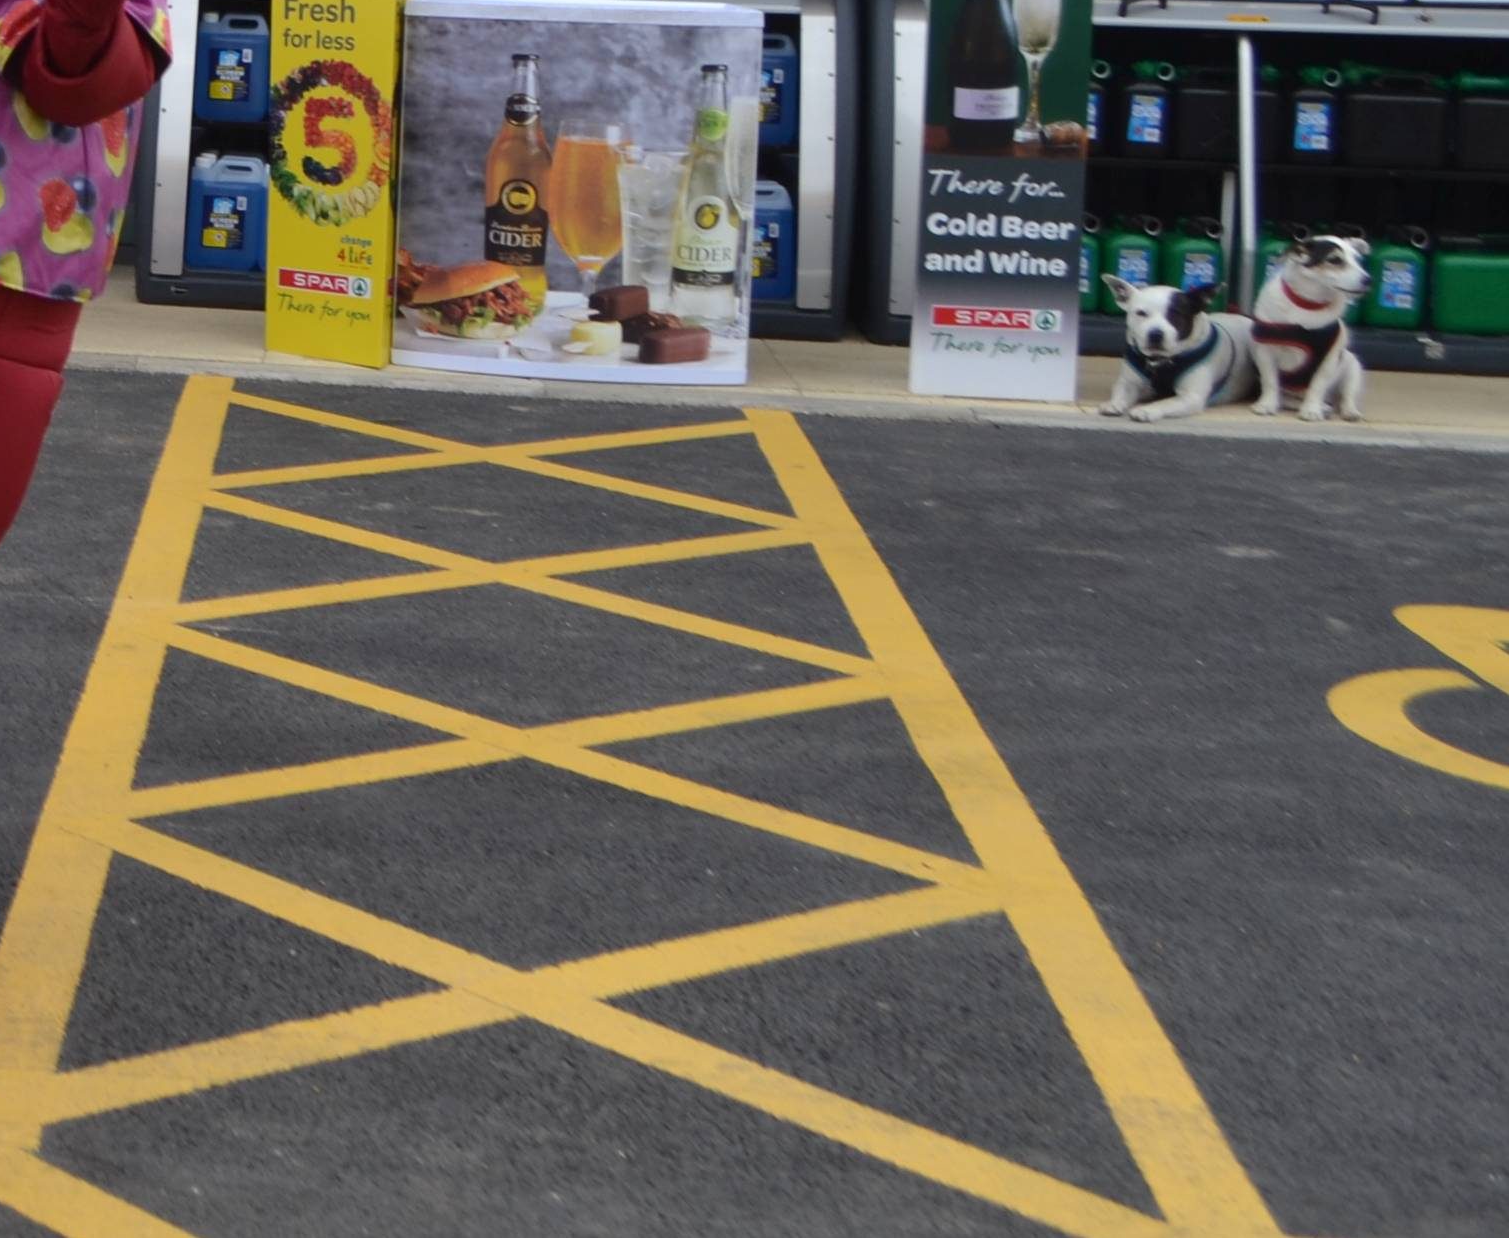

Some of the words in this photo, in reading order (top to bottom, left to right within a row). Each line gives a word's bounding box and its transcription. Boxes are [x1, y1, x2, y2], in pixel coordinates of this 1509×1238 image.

[282, 28, 312, 48] for
[316, 29, 355, 51] less
[302, 96, 358, 186] 5
[928, 169, 1004, 196] There
[489, 229, 542, 248] CIDER
[926, 212, 996, 238] Cold
[1001, 215, 1076, 241] Beer
[677, 244, 732, 262] CIDER
[924, 249, 984, 273] and
[988, 250, 1069, 278] Wine
[293, 272, 349, 293] SPAR
[278, 293, 314, 313] There
[319, 303, 342, 321] for
[346, 310, 371, 326] you
[954, 310, 1030, 327] SPAR
[930, 332, 984, 353] There
[990, 336, 1022, 357] for
[1026, 346, 1062, 362] you
